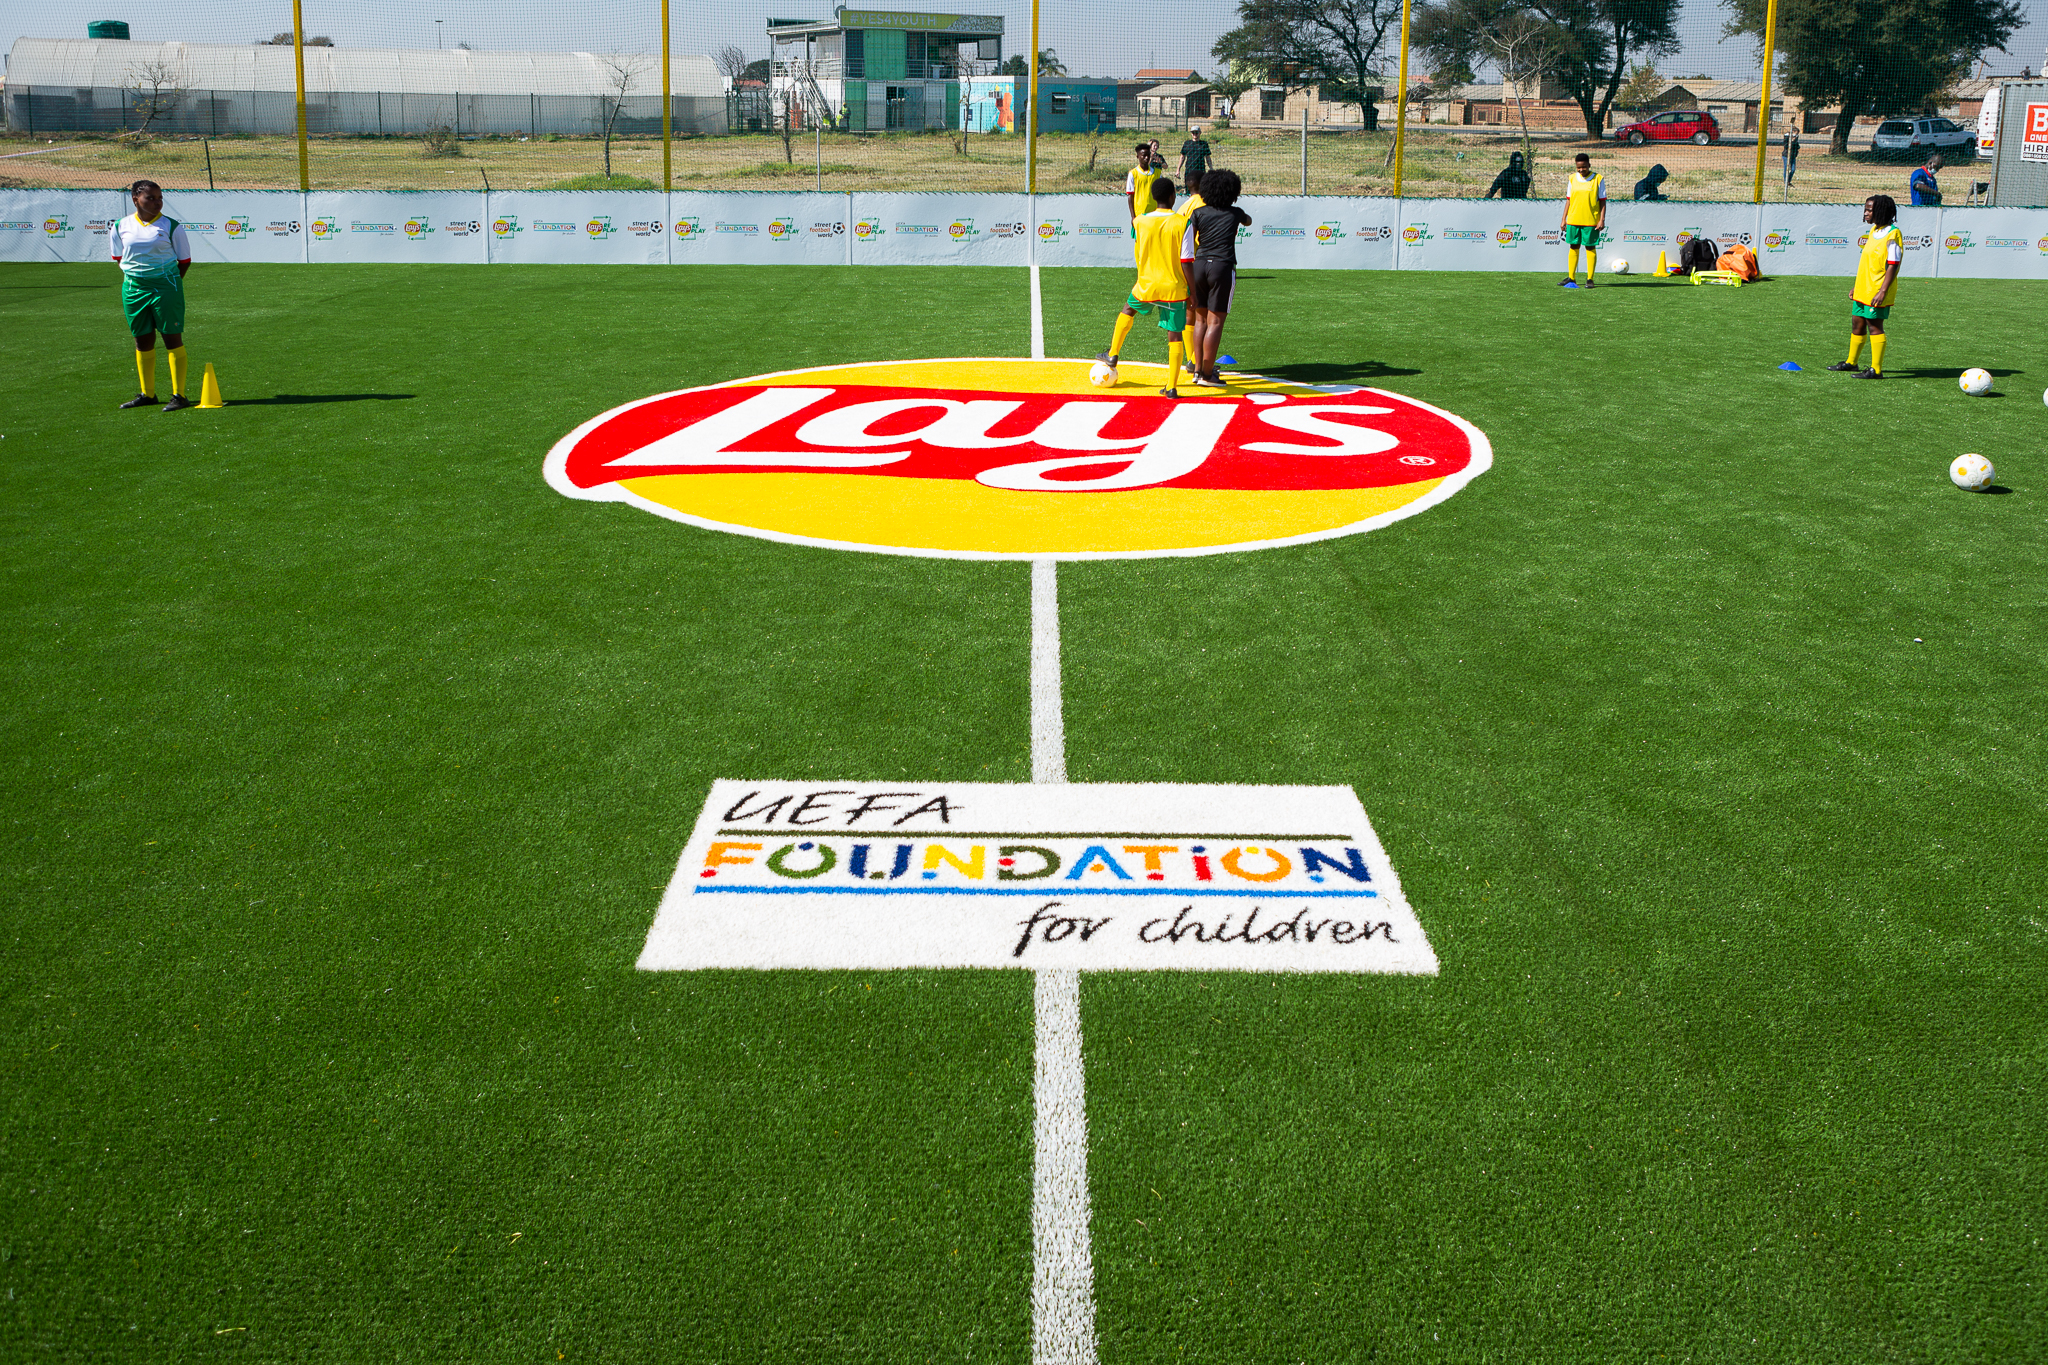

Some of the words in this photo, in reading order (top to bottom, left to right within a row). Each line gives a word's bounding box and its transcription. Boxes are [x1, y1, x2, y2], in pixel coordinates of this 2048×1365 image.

[850, 13, 936, 26] #YES4YOUTH
[601, 388, 1400, 490] Lay's
[723, 791, 964, 825] UEFA
[700, 841, 1371, 883] FOUNDATION
[1013, 902, 1113, 957] for
[1139, 905, 1400, 943] children
